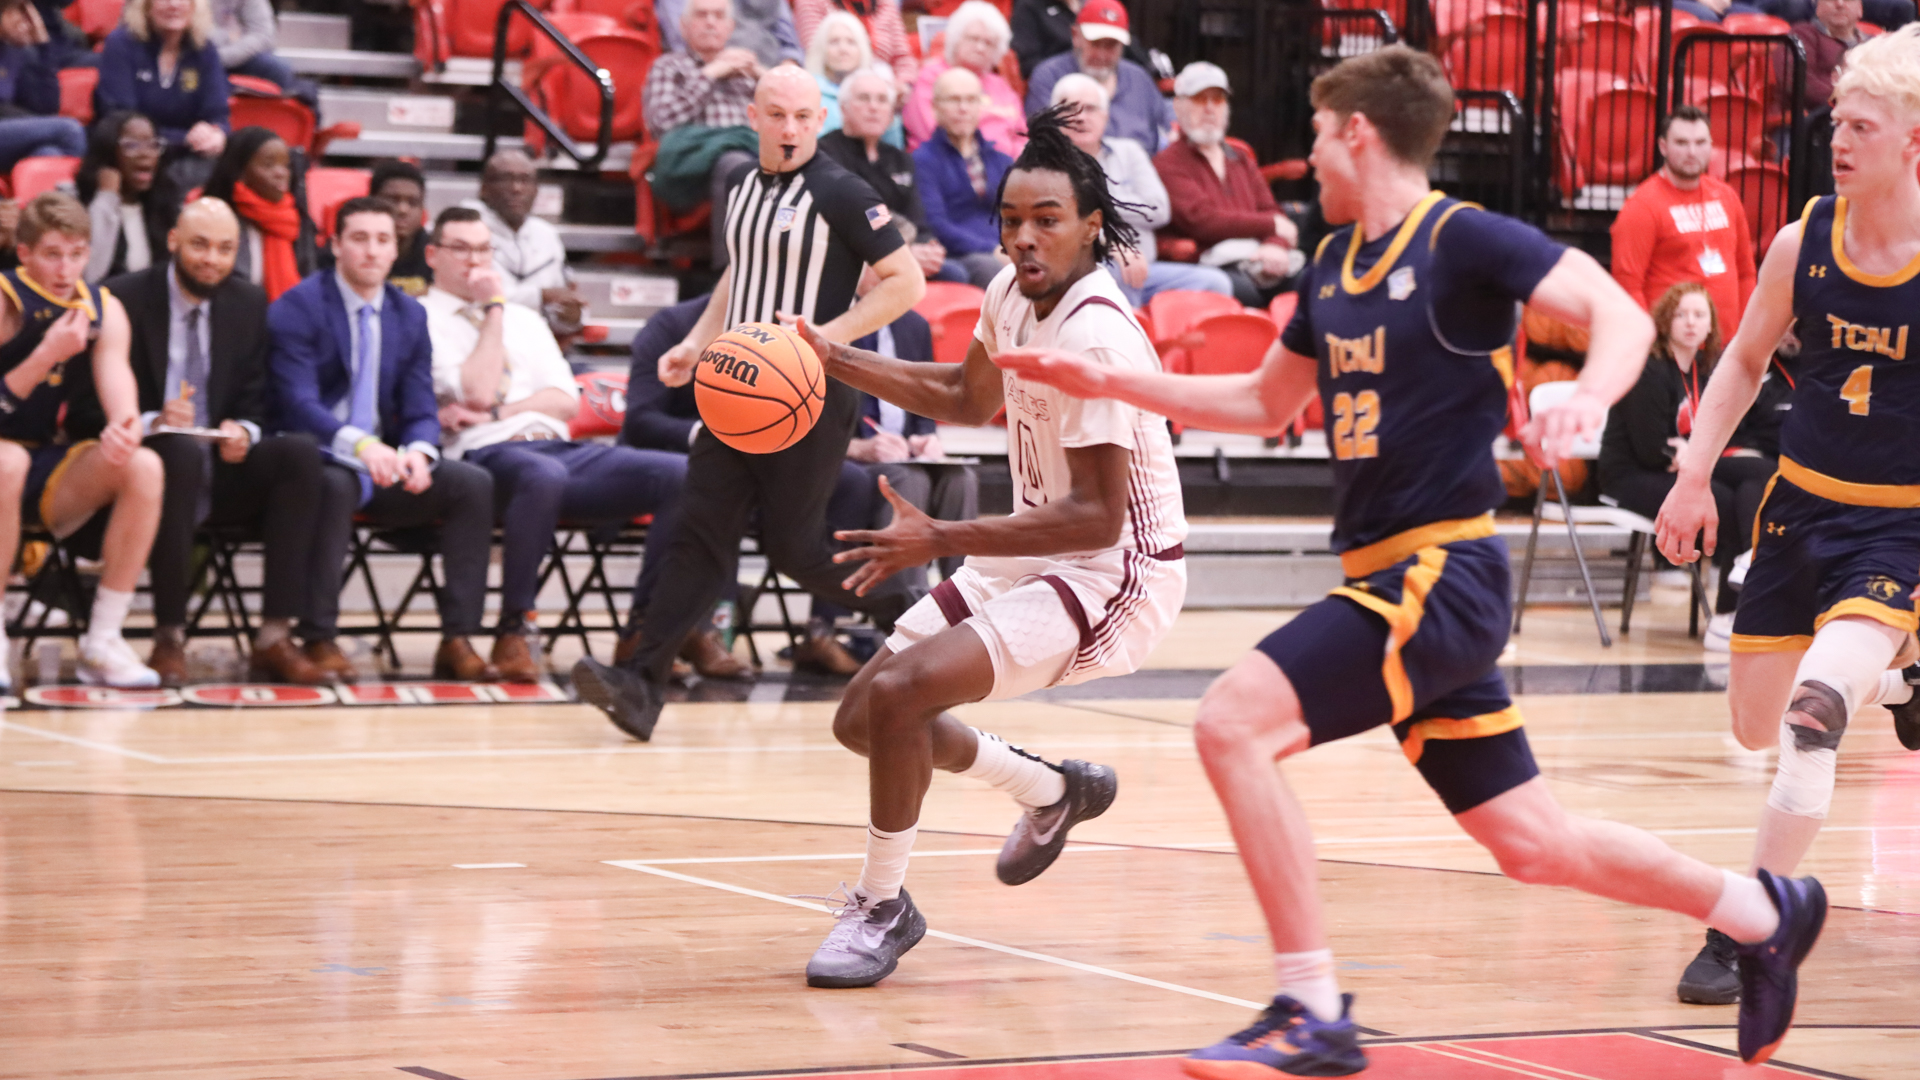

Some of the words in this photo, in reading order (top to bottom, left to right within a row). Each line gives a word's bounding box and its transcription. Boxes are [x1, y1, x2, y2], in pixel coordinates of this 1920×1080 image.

[1826, 313, 1910, 361] TCNJ
[1839, 364, 1874, 416] 4
[1333, 389, 1381, 461] 22
[1017, 418, 1048, 508] 0
